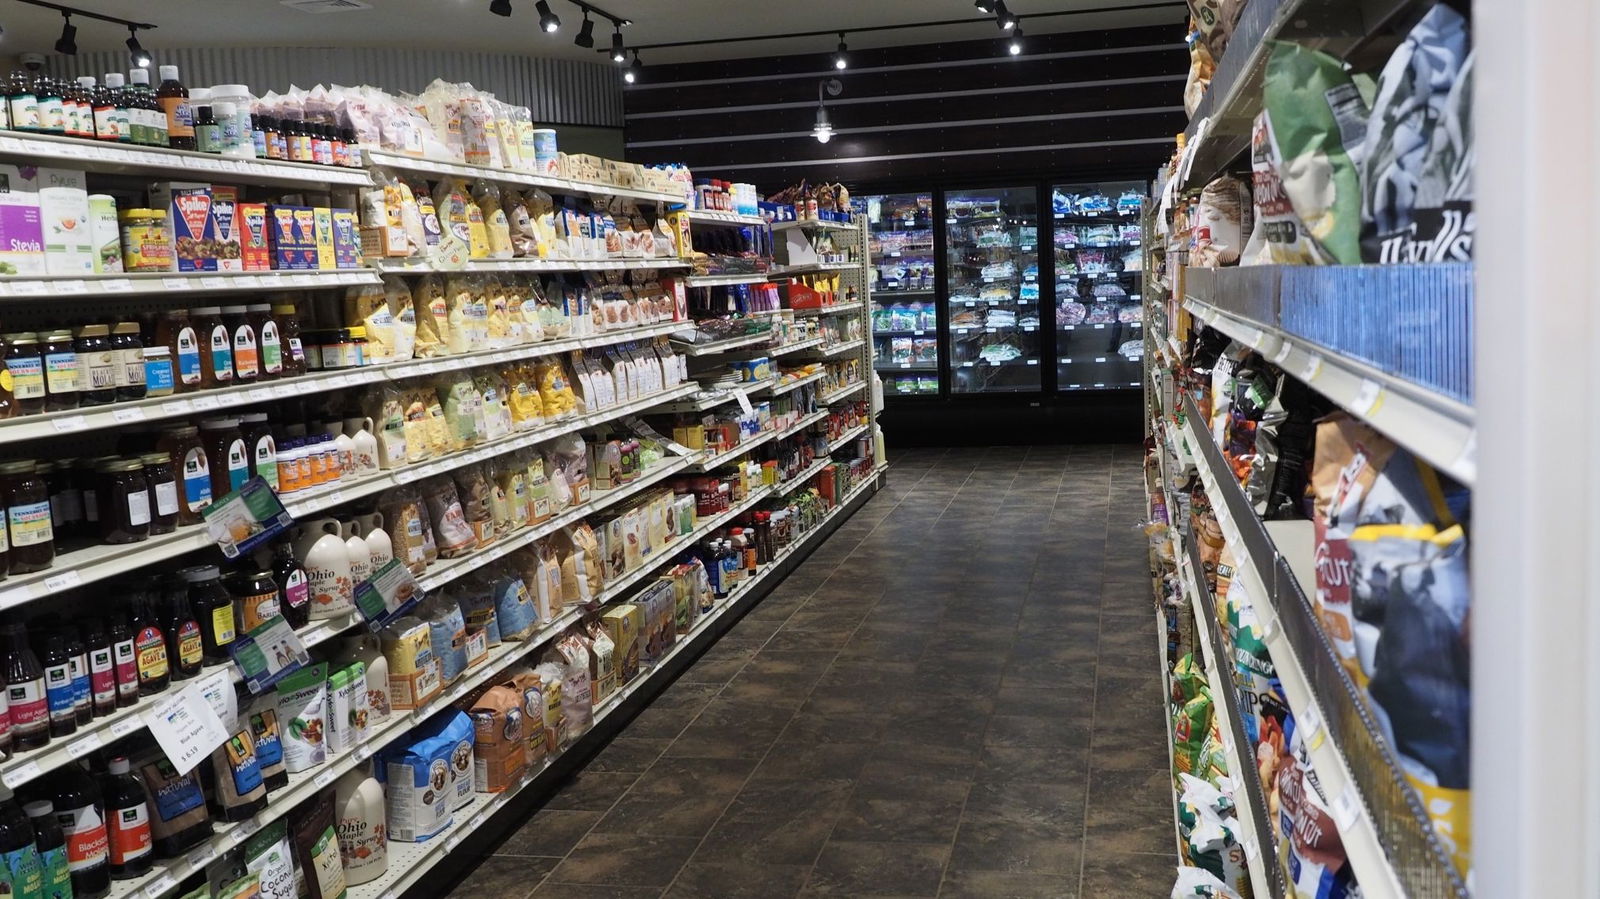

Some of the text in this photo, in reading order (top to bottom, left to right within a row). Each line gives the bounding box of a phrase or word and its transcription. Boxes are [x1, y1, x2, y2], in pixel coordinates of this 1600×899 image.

[181, 196, 207, 214] Spike
[10, 238, 41, 253] Stevia
[370, 555, 389, 564] Ohio
[350, 562, 369, 573] Ohio
[308, 569, 335, 581] Ohio
[309, 579, 325, 588] aple
[318, 585, 340, 593] Syrup
[183, 641, 198, 654] AGAVE
[142, 652, 160, 666] AGAVE
[255, 733, 277, 749] atural
[158, 774, 193, 797] natural
[337, 821, 367, 835] Ohio
[338, 830, 363, 841] Maple
[356, 835, 378, 846] Syrup
[272, 880, 294, 899] Sugar
